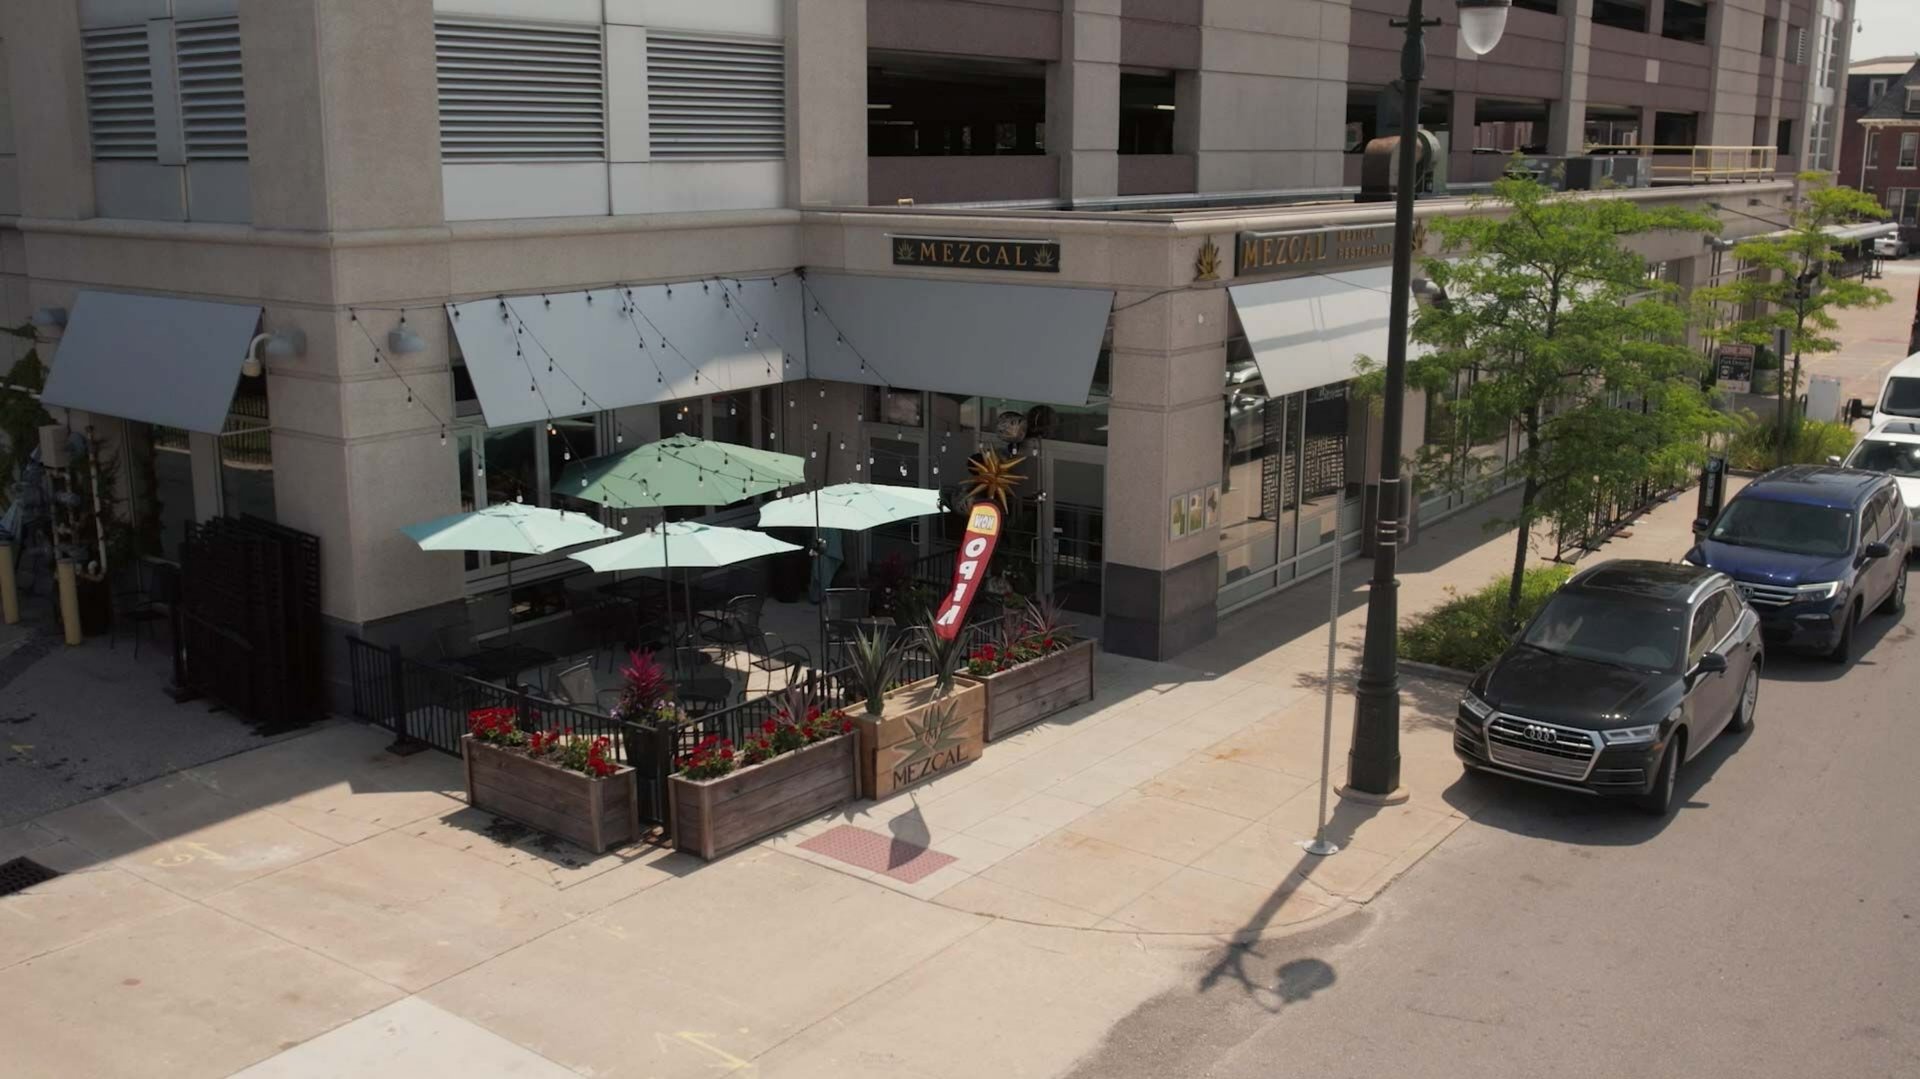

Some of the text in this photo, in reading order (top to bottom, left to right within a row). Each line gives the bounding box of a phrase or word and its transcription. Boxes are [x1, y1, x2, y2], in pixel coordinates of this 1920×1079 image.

[919, 242, 1027, 266] MEZCAL
[1243, 232, 1326, 269] MEZCAL
[893, 744, 968, 791] MEZCAL
